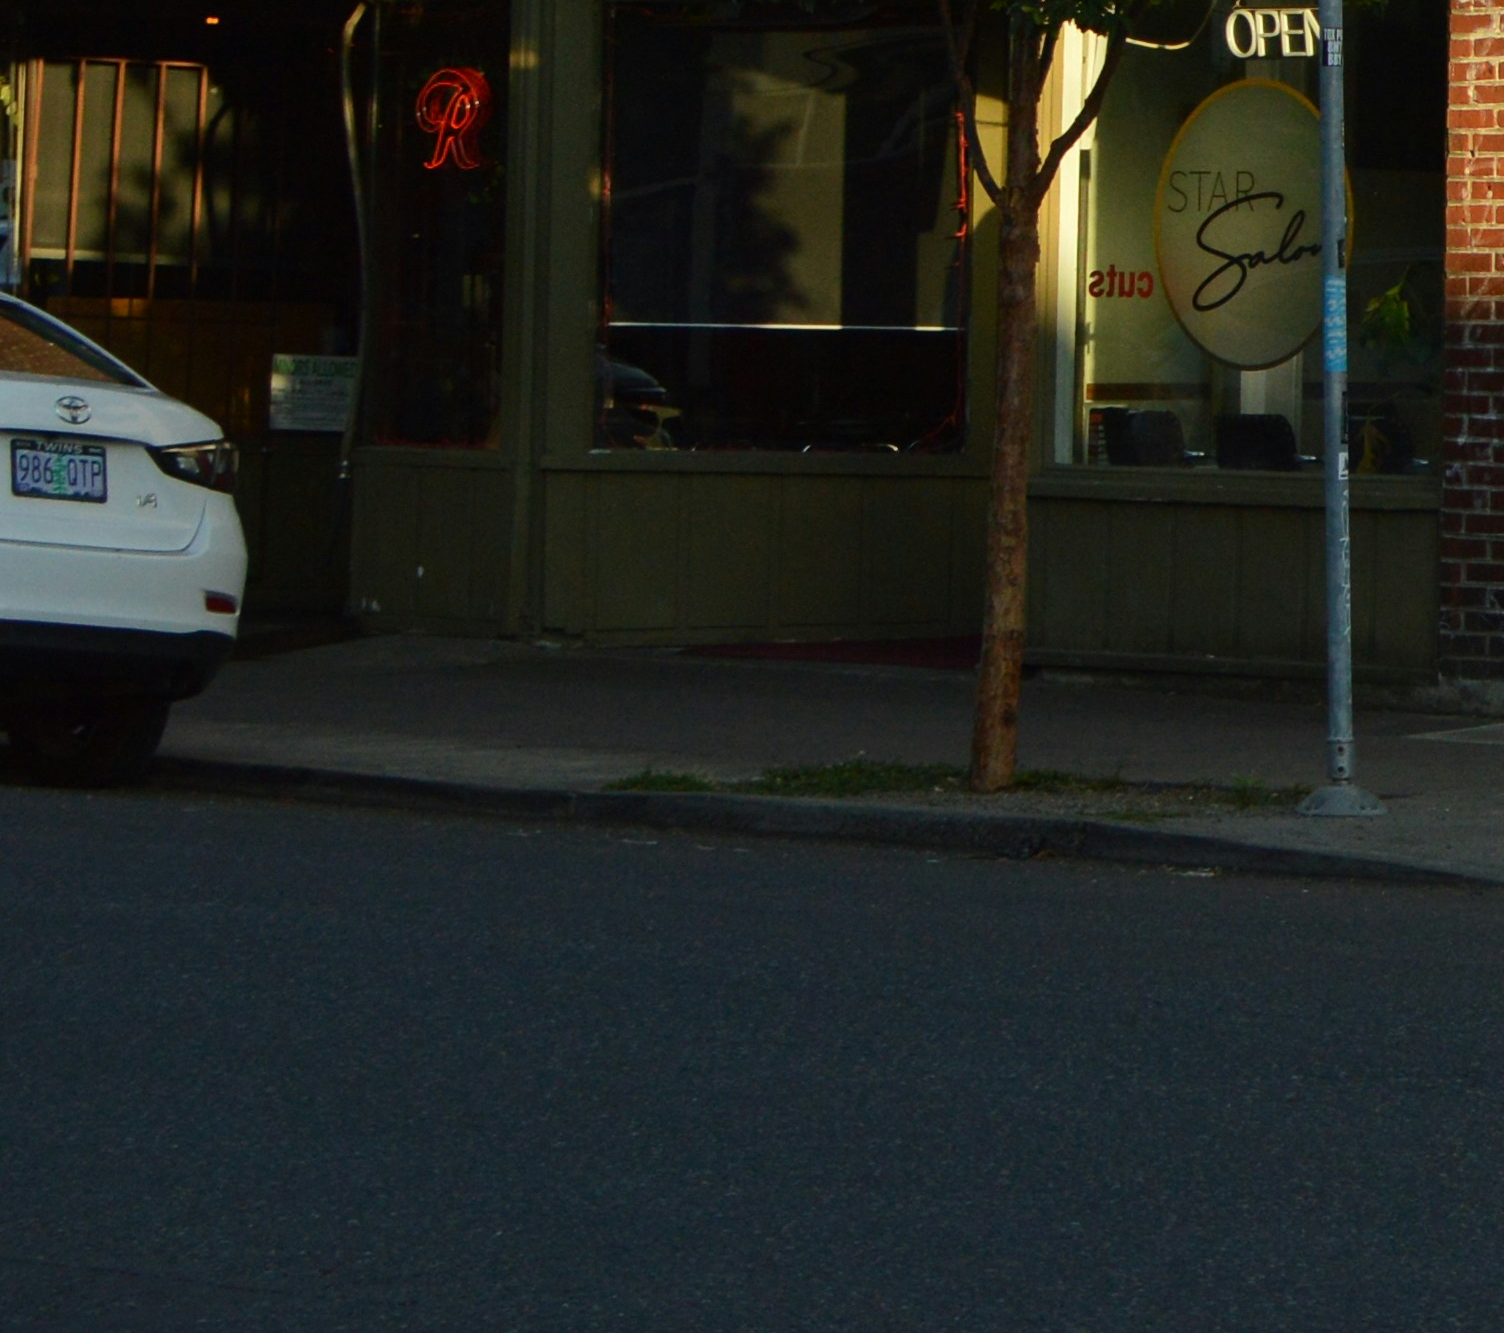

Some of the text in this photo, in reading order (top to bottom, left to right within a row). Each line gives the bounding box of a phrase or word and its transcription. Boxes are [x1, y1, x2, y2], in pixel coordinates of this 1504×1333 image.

[1167, 170, 1256, 213] STAR
[36, 441, 83, 455] TWINS
[19, 454, 102, 487] 986 QTP
